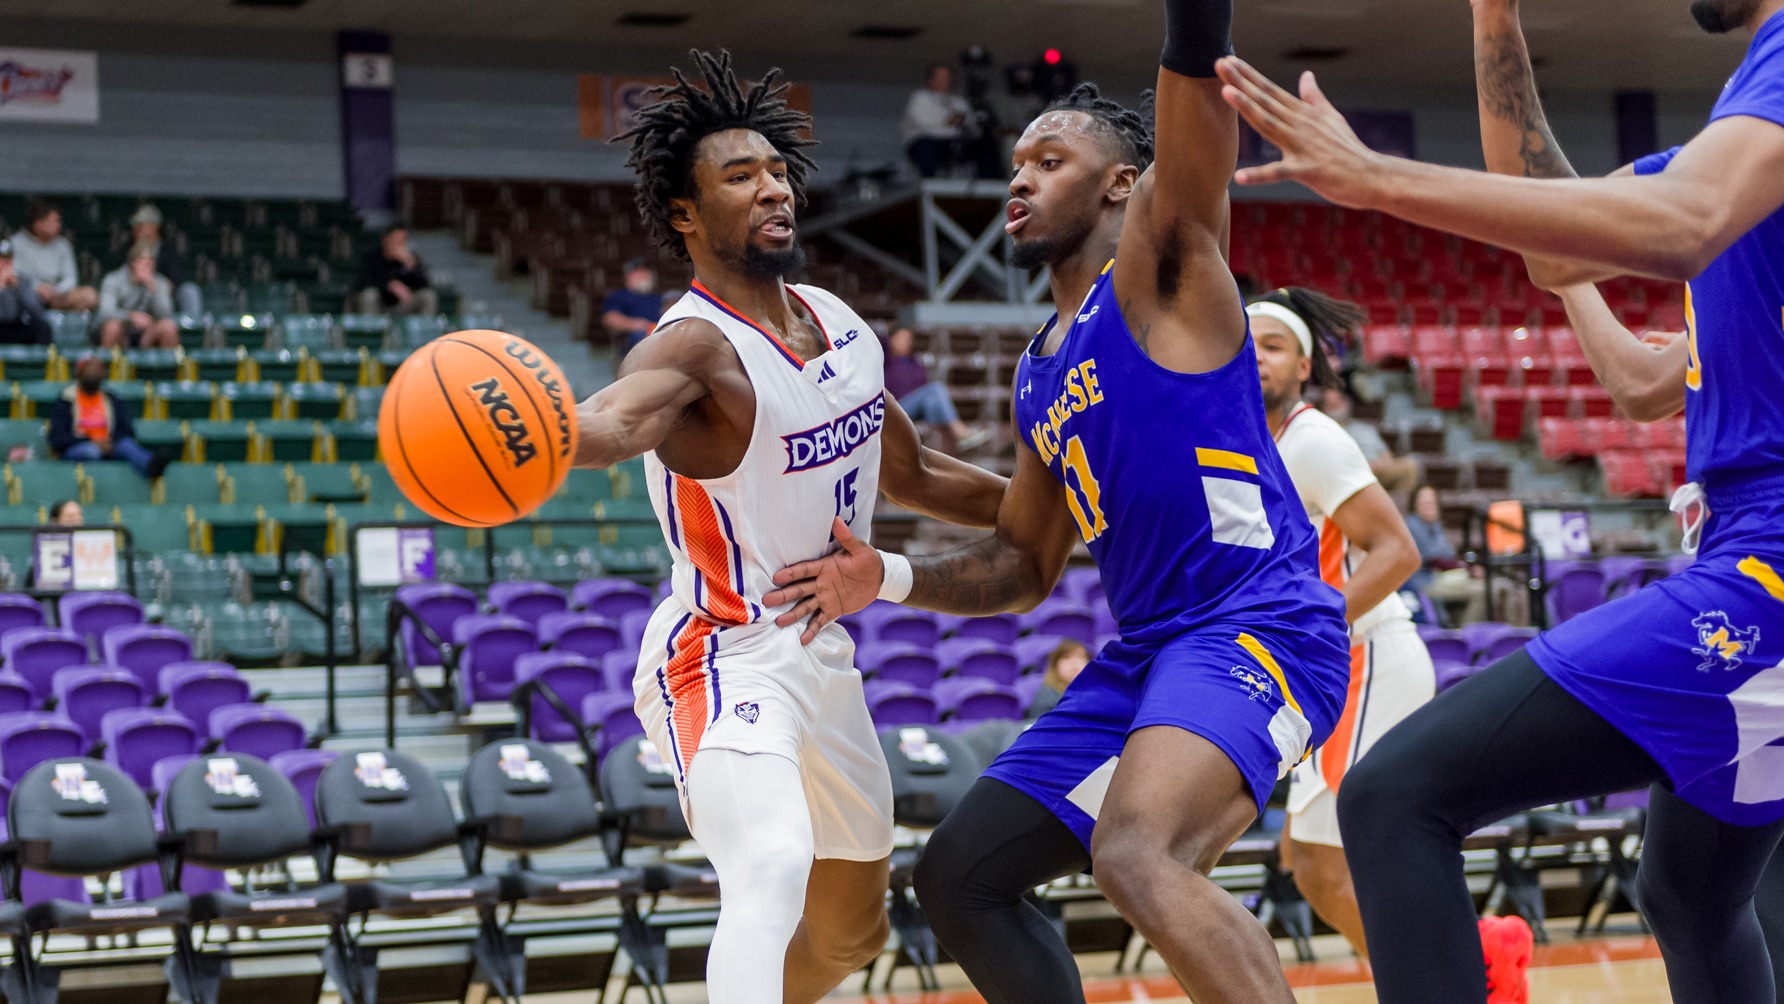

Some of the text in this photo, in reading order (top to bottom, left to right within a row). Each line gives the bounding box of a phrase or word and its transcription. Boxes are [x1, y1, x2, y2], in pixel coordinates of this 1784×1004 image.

[470, 376, 538, 468] NCAA
[790, 396, 886, 468] DEMONS
[829, 466, 860, 543] 15
[41, 541, 71, 581] E
